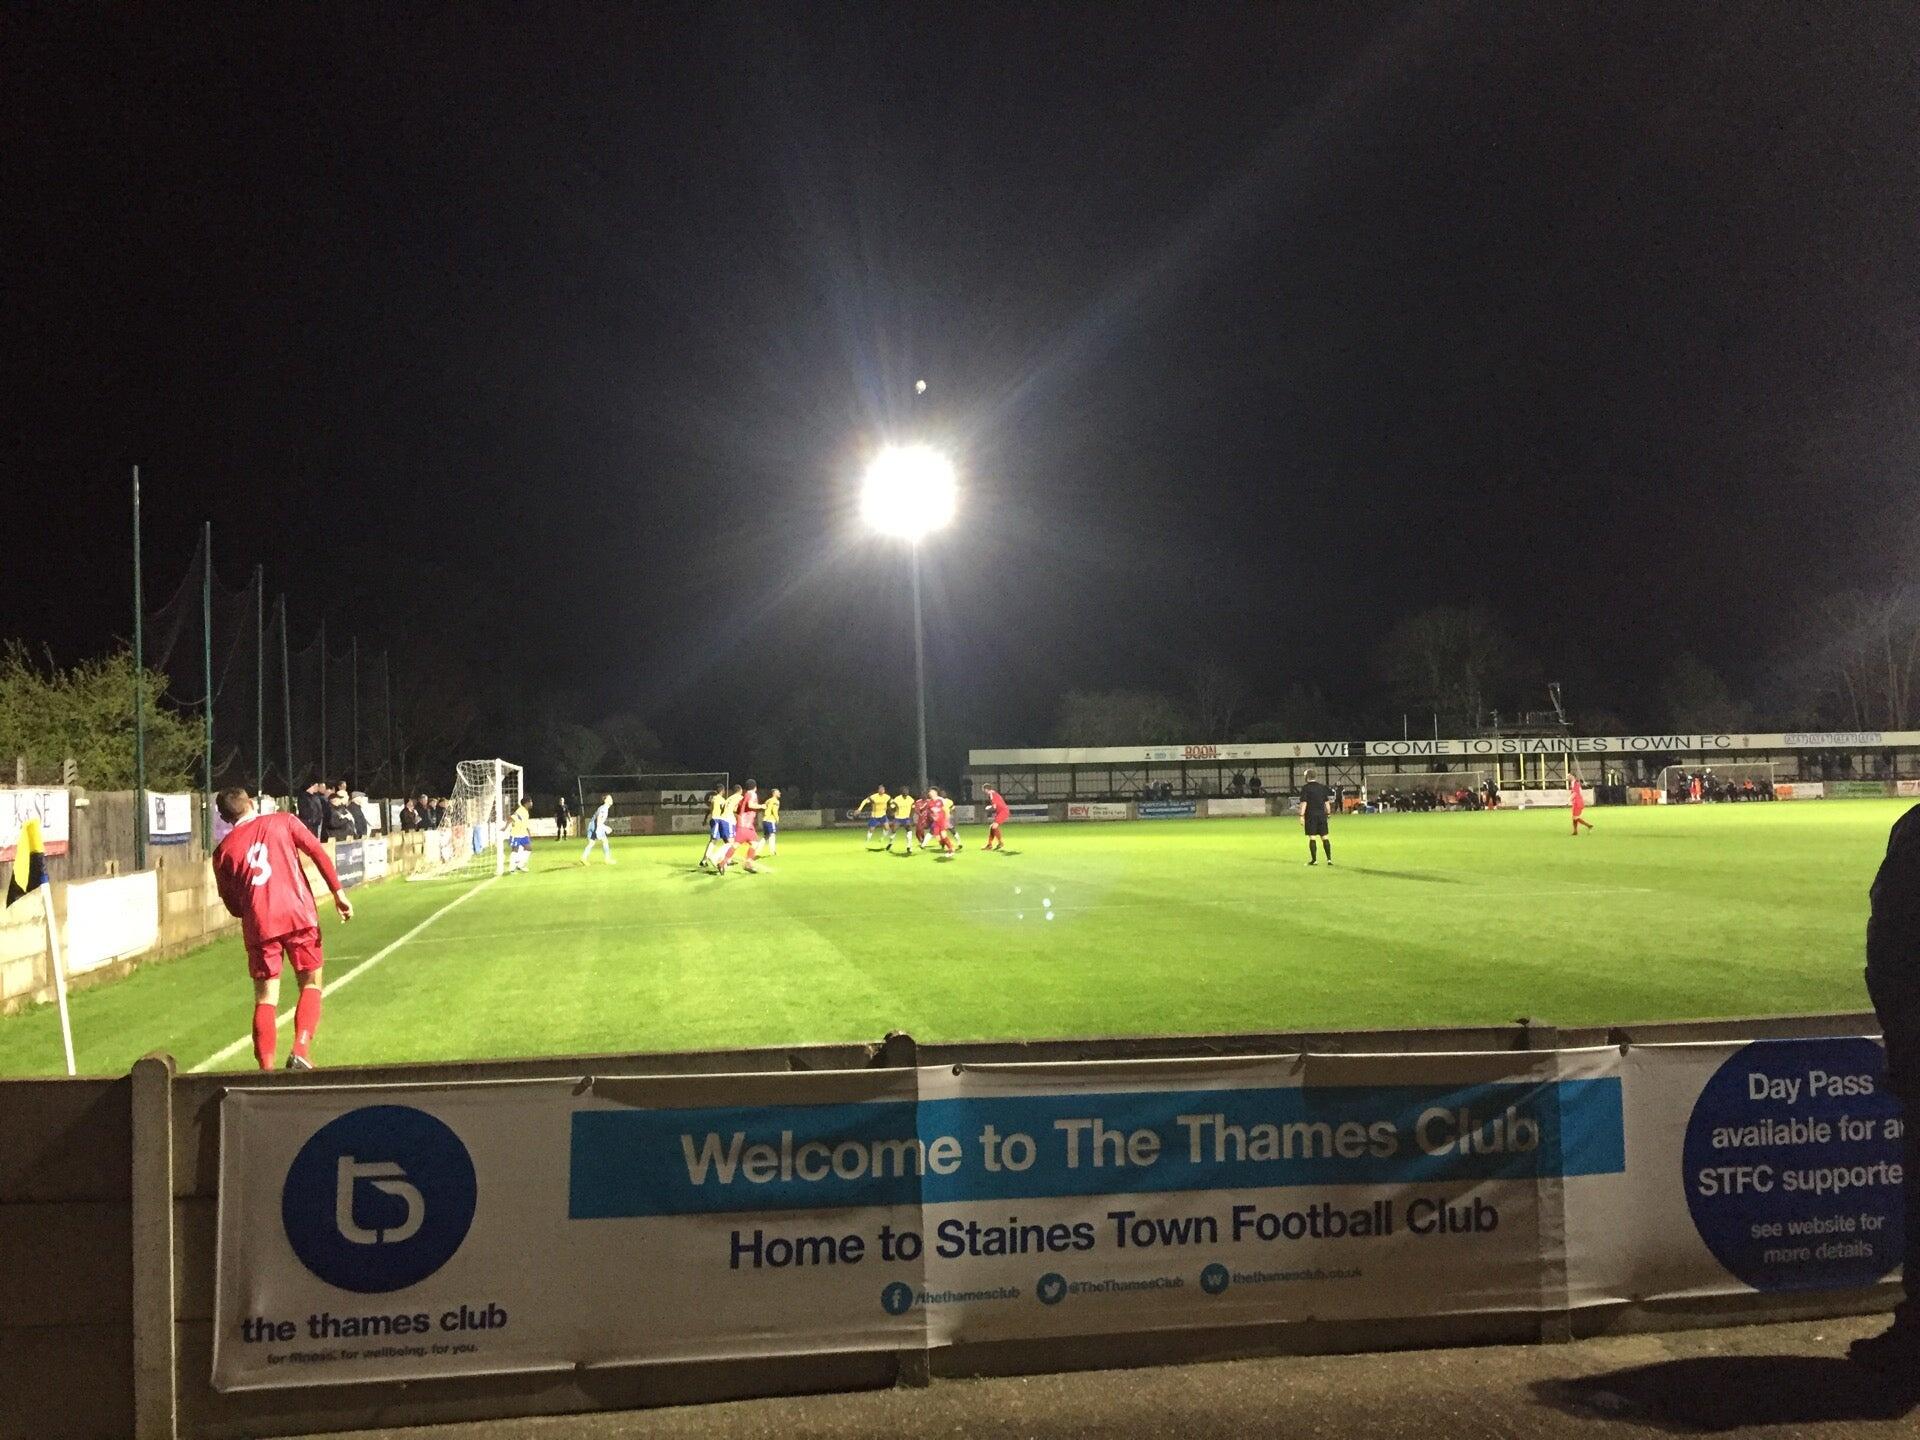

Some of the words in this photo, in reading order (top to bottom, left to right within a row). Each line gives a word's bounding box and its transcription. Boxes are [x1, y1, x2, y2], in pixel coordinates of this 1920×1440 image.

[1458, 740, 1492, 753] TO
[1502, 737, 1607, 753] STAINES
[1616, 736, 1691, 751] TOWN
[1700, 735, 1731, 749] FC
[1749, 1072, 1801, 1105] Day
[1809, 1070, 1875, 1097] Pass
[681, 1130, 963, 1186] Welcome
[979, 1124, 1037, 1173] to
[1053, 1117, 1162, 1168] The
[1177, 1112, 1398, 1164] Thames
[1416, 1106, 1540, 1157] Club
[1712, 1116, 1832, 1149] available
[1838, 1114, 1877, 1141] for
[1698, 1164, 1774, 1196] STFC
[730, 1229, 865, 1269] Home
[878, 1225, 922, 1262] to
[936, 1216, 1095, 1258] Staines
[1107, 1210, 1217, 1249] Town
[1232, 1200, 1392, 1243] Football
[1406, 1197, 1499, 1236] Club
[1751, 1222, 1783, 1239] see
[1788, 1214, 1856, 1236] website
[1860, 1212, 1885, 1231] for
[1764, 1247, 1811, 1263] more
[1816, 1240, 1873, 1260] details
[241, 1317, 296, 1344] the
[307, 1312, 430, 1339] thames
[439, 1303, 508, 1332] club
[267, 1353, 287, 1364] for
[341, 1350, 360, 1360] for
[432, 1344, 450, 1354] for
